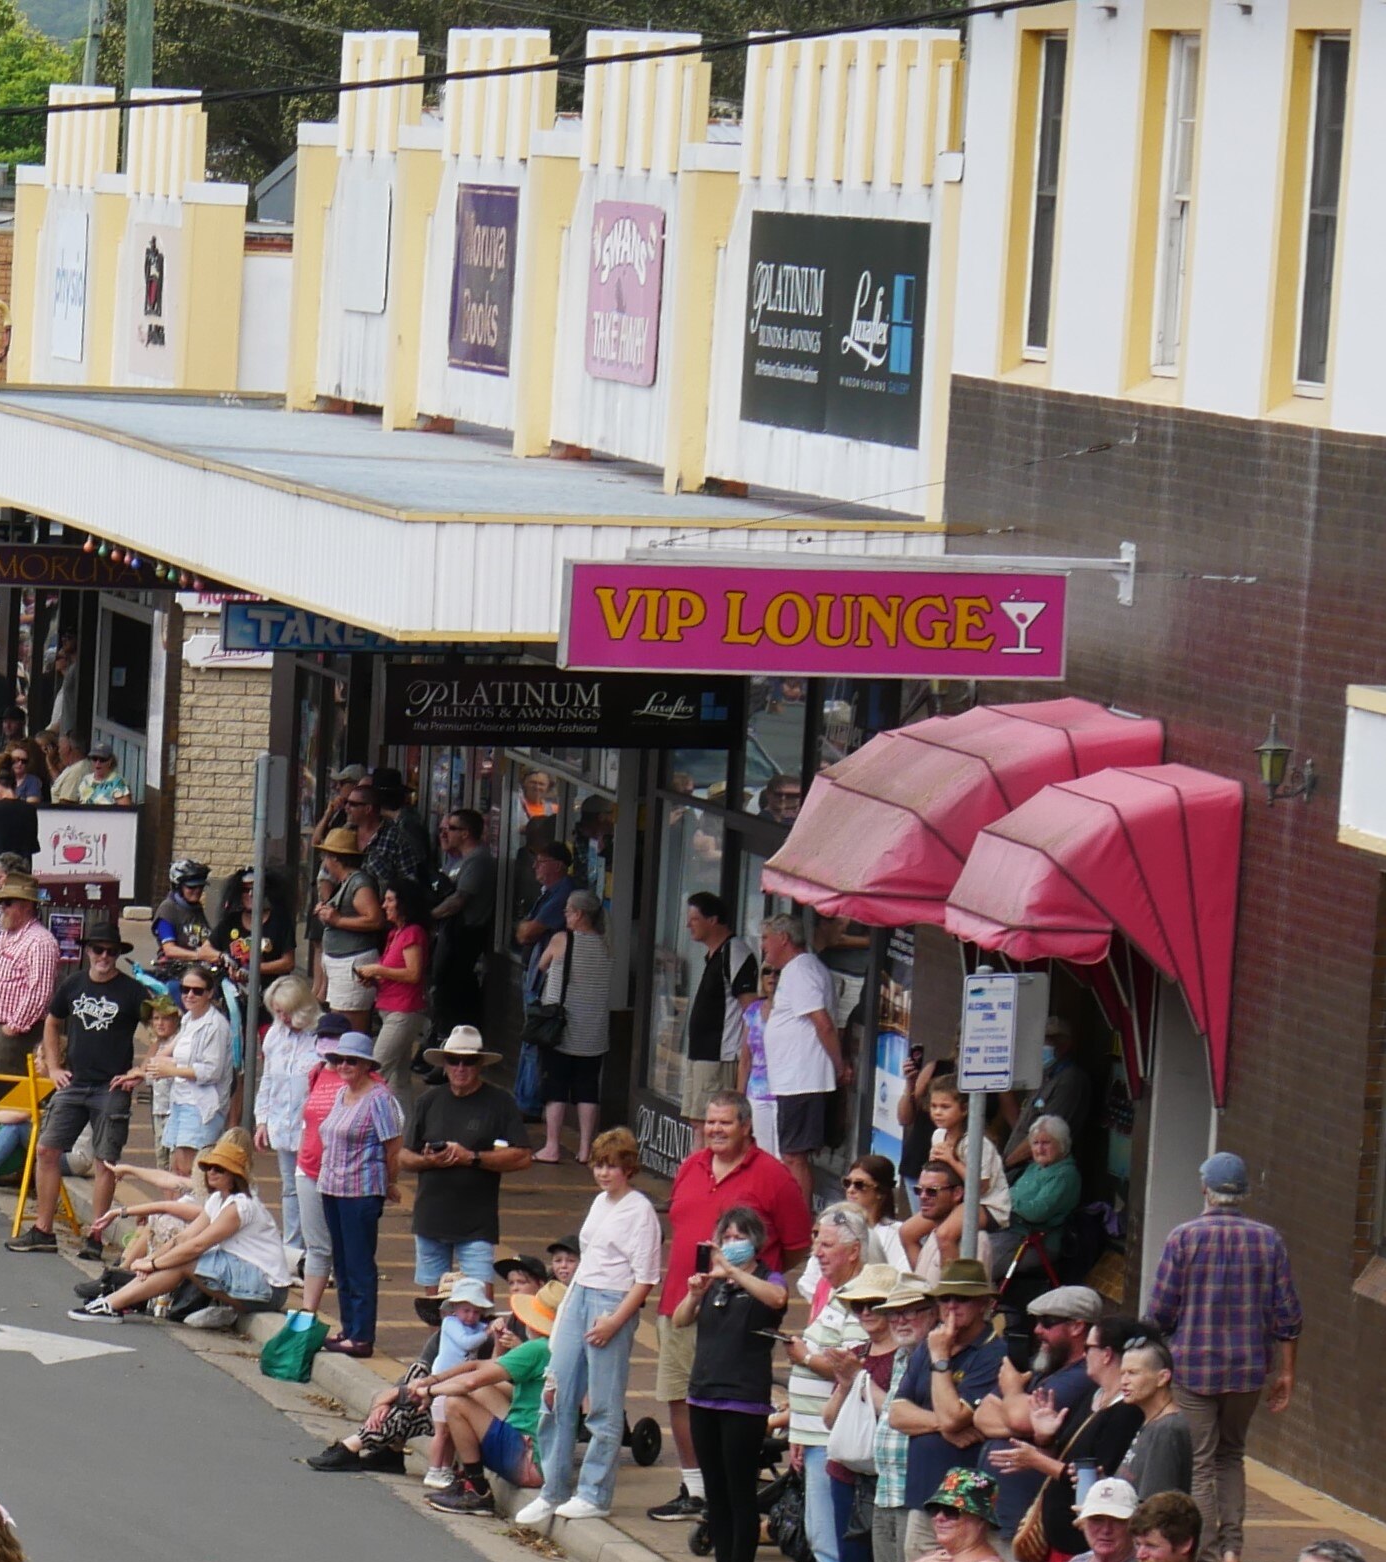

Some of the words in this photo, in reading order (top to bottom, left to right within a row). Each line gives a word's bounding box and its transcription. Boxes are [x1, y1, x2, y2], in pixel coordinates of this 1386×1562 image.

[464, 211, 507, 281] Moruya
[600, 218, 647, 286] SWANS
[461, 288, 499, 348] Books
[750, 260, 826, 334] PLATINUM
[594, 586, 707, 642] VIP
[722, 589, 996, 652] LOUNGE
[405, 679, 603, 717] PLATINUM
[413, 721, 428, 731] the
[429, 721, 472, 732] Premium
[474, 722, 504, 732] Choice
[517, 722, 555, 733] Window
[557, 722, 598, 733] Fashions
[432, 706, 494, 719] BLINDS
[498, 707, 512, 718] &
[517, 707, 601, 720] AWNINGS
[631, 691, 697, 721] Luxaflex
[636, 1104, 694, 1161] PLATINU
